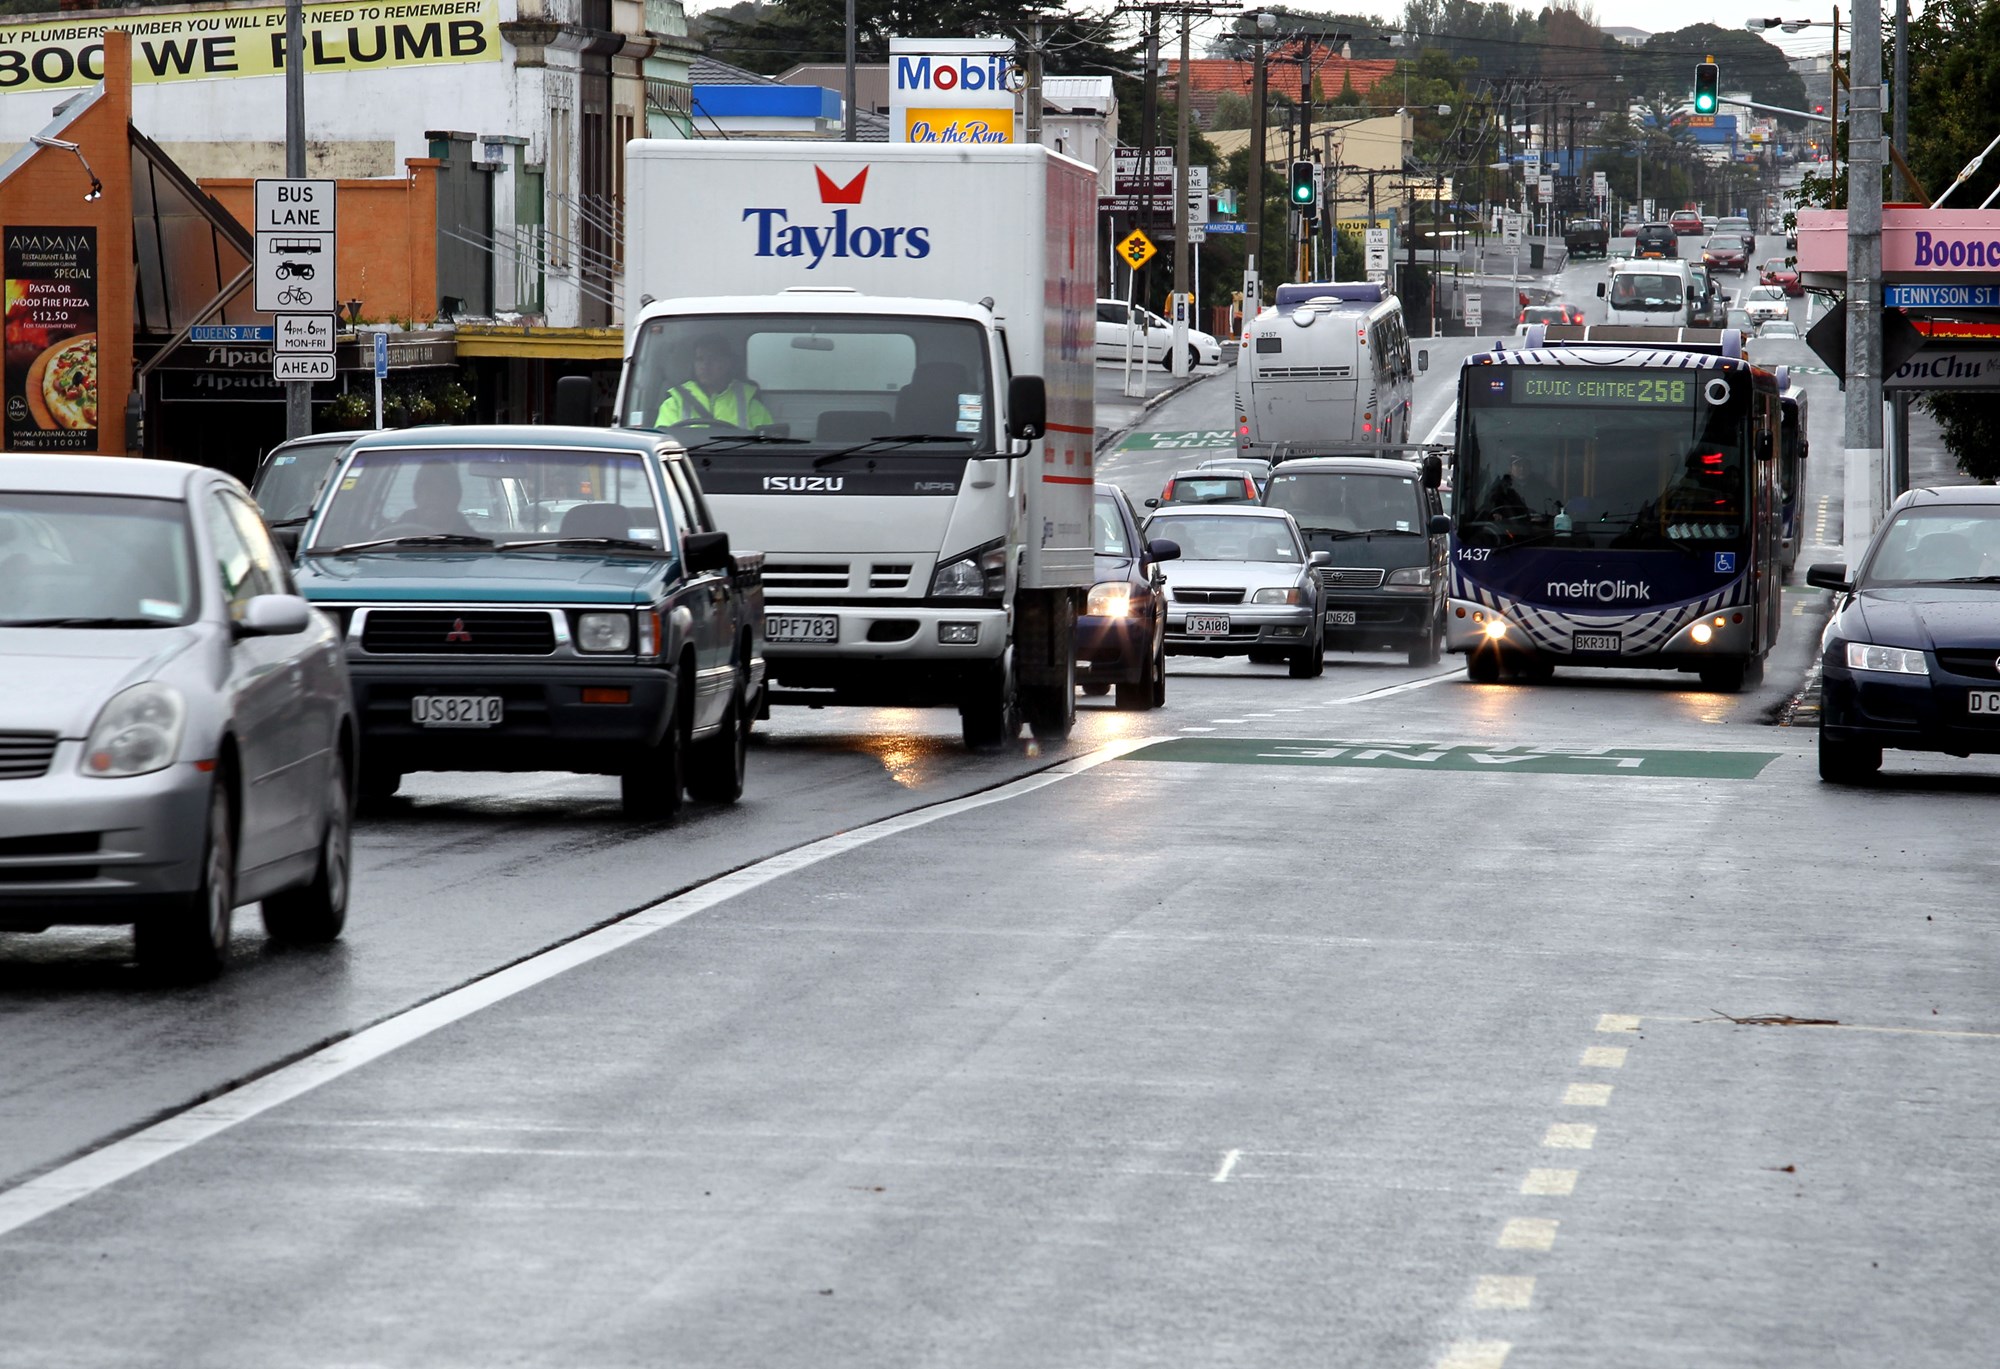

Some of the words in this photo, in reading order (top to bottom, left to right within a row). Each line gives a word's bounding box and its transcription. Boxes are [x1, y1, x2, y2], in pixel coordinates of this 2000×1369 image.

[21, 26, 108, 43] PLUMBERS
[187, 19, 220, 31] YOU
[225, 16, 260, 29] WILL
[266, 13, 307, 27] EV
[311, 10, 354, 23] NEED
[359, 8, 380, 20] TO
[384, 2, 481, 18] REMEMBER!
[141, 36, 238, 76] WE
[898, 56, 1006, 90] Mobil
[910, 121, 939, 143] On
[941, 121, 968, 143] the
[965, 121, 1007, 143] Run
[278, 187, 313, 202] BUS
[272, 210, 320, 225] LANE
[1338, 222, 1382, 230] YOUNS
[9, 236, 90, 251] APADANA
[742, 208, 931, 270] Taylors
[55, 268, 91, 279] SPECIAL
[29, 284, 55, 293] PASTA
[57, 285, 71, 293] OR
[1893, 287, 1969, 304] TENNYSON
[1974, 287, 1993, 304] ST
[11, 298, 40, 307] WOOD
[42, 298, 60, 307] FIRE
[63, 298, 89, 307] PIZZA
[195, 327, 237, 339] QUEENS
[242, 327, 261, 339] AVE
[285, 339, 326, 347] MON-FRI
[205, 347, 273, 367] Apad
[281, 362, 329, 374] AHEAD
[1896, 355, 1982, 378] onChu
[1526, 380, 1572, 396] CIVIC
[1577, 382, 1636, 398] CENTRE
[1637, 380, 1685, 403] 258
[1149, 431, 1237, 441] LAN
[763, 477, 844, 491] ISUZU
[914, 482, 955, 491] NPR
[1457, 548, 1491, 561] 1437
[768, 619, 835, 636] DPF783
[1576, 635, 1618, 650] BKR311
[416, 699, 500, 721] US8210
